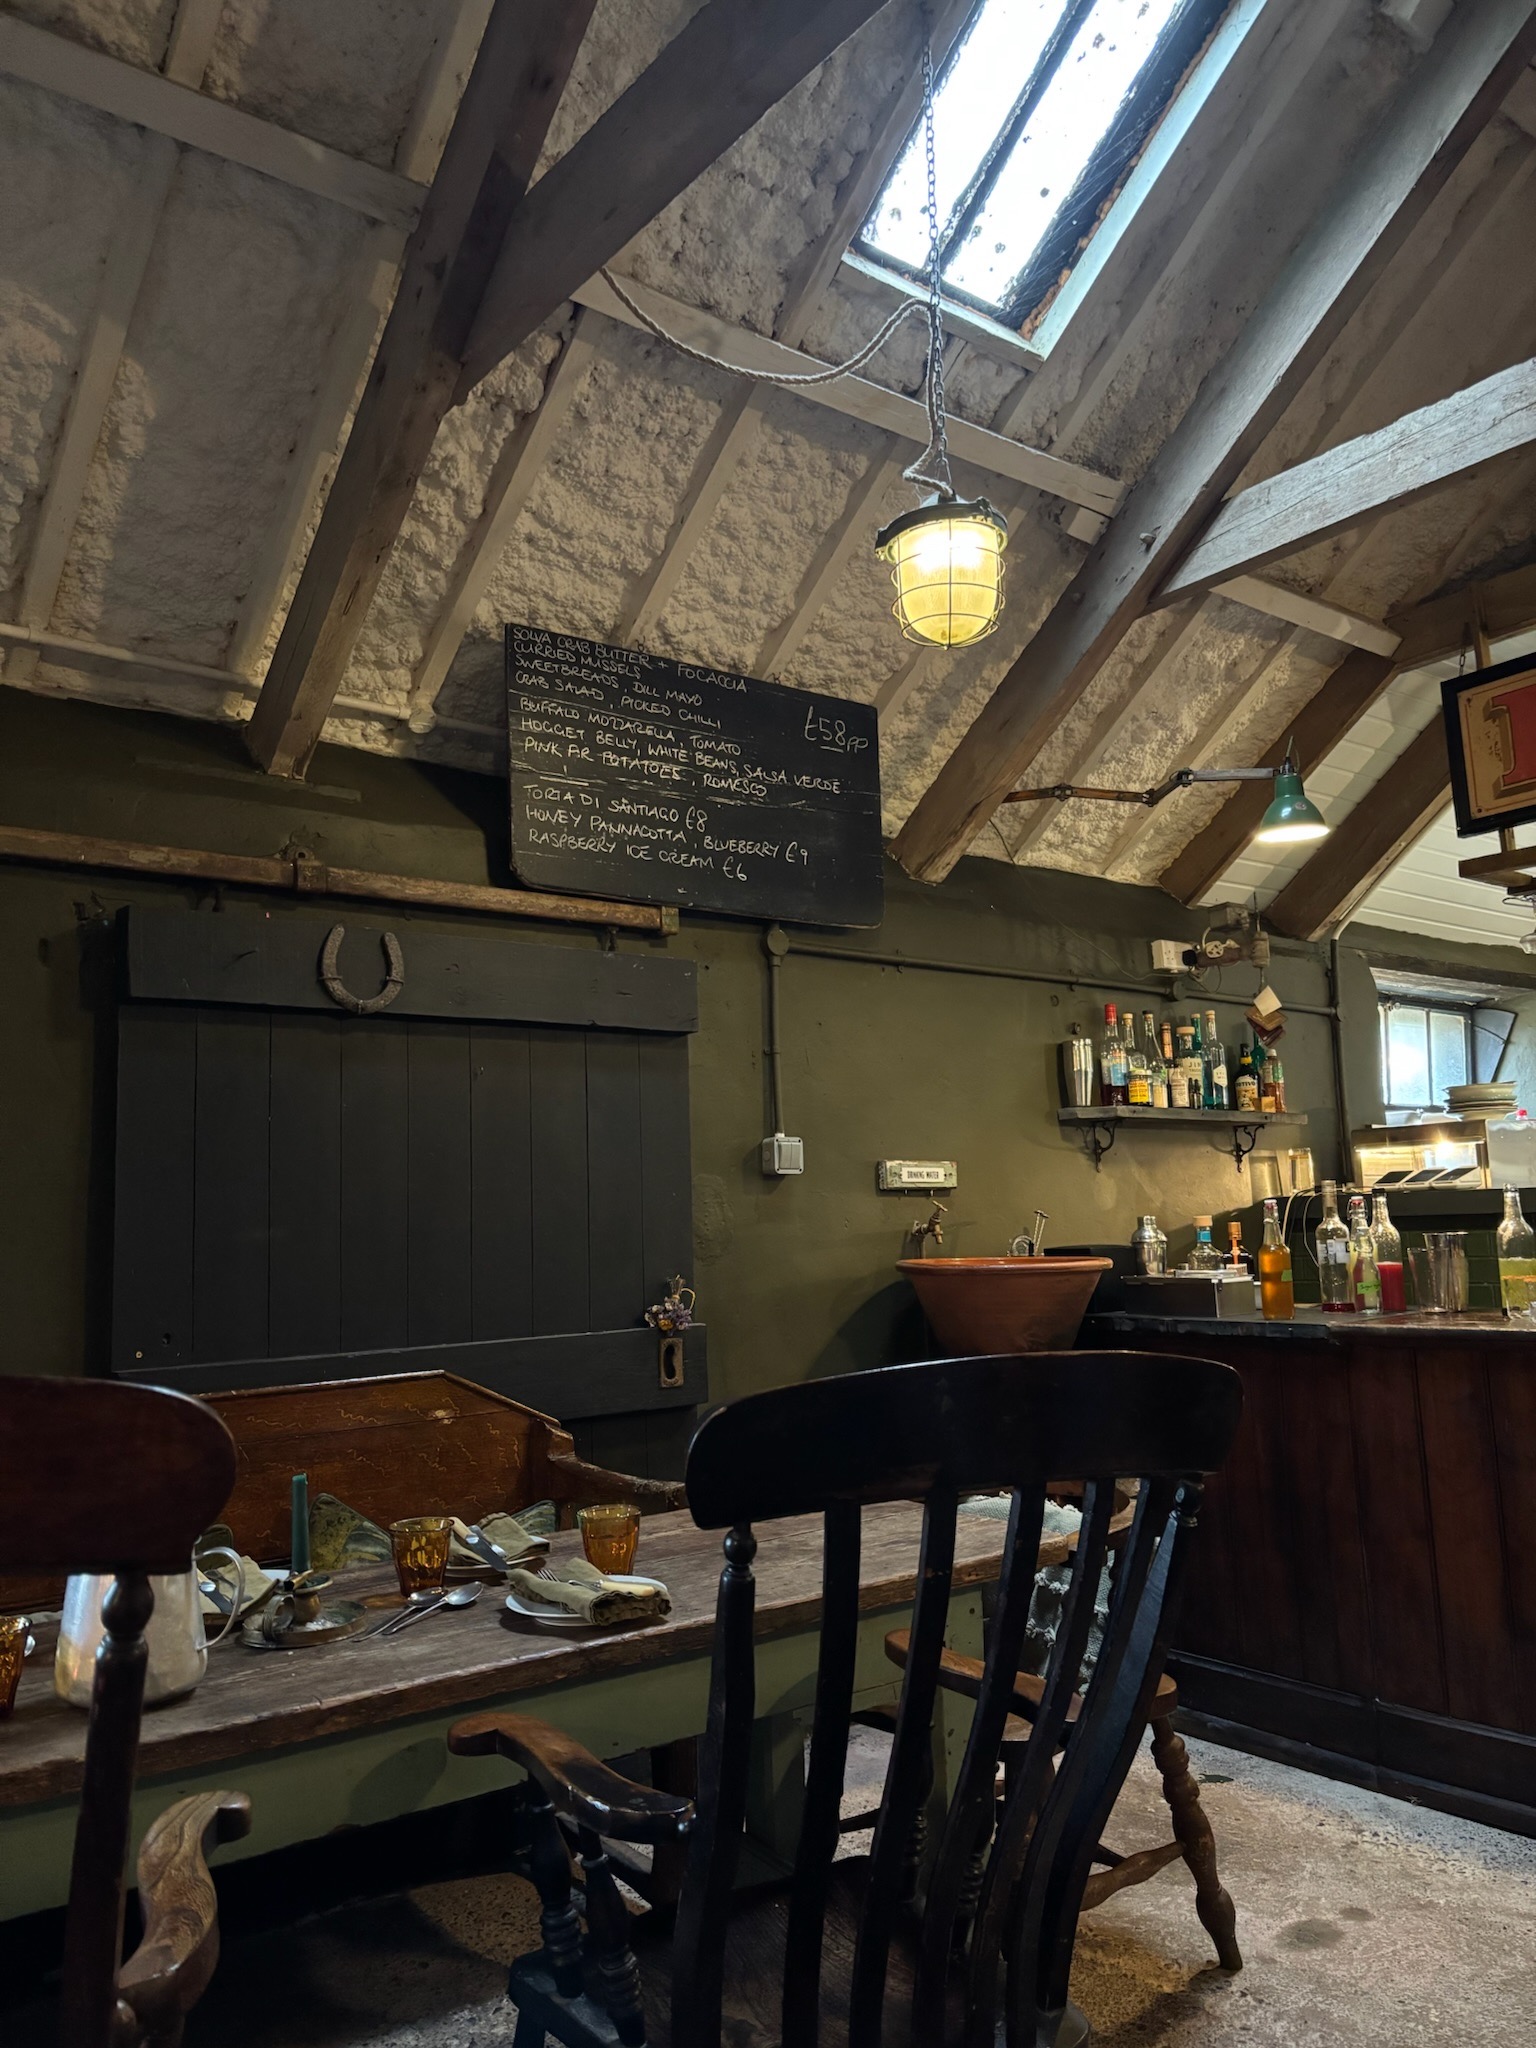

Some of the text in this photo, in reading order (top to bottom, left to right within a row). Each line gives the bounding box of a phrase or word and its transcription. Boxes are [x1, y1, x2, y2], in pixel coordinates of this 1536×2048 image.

[513, 641, 641, 680] CURRIED MUSSELS
[557, 636, 591, 655] CRAB
[595, 643, 653, 670] BUTTER
[677, 663, 747, 693] FOCACCIA
[515, 671, 550, 690] CRAB
[620, 695, 671, 717] PICKED
[678, 708, 721, 730] CHILLI
[632, 681, 660, 698] DILL
[665, 690, 703, 707] MAYO
[520, 697, 580, 720] BUFFALO
[689, 734, 741, 756] TOMATO
[521, 716, 585, 740] HOGGET
[648, 743, 690, 763] WHITE
[744, 764, 787, 784] SALSA
[794, 774, 842, 795] VERDE
[524, 736, 562, 758] PINK
[703, 773, 767, 797] ROMESCO
[522, 783, 575, 805] TORTA
[580, 793, 600, 809] DI
[608, 798, 680, 823] SANTIAGO
[525, 804, 582, 828] HONEY
[703, 835, 780, 859] BLUEBERRY
[528, 828, 617, 854] RASPBERRY
[626, 844, 654, 861] ICE
[658, 849, 715, 870] CREAM
[907, 1170, 939, 1179] DRINKING WATER
